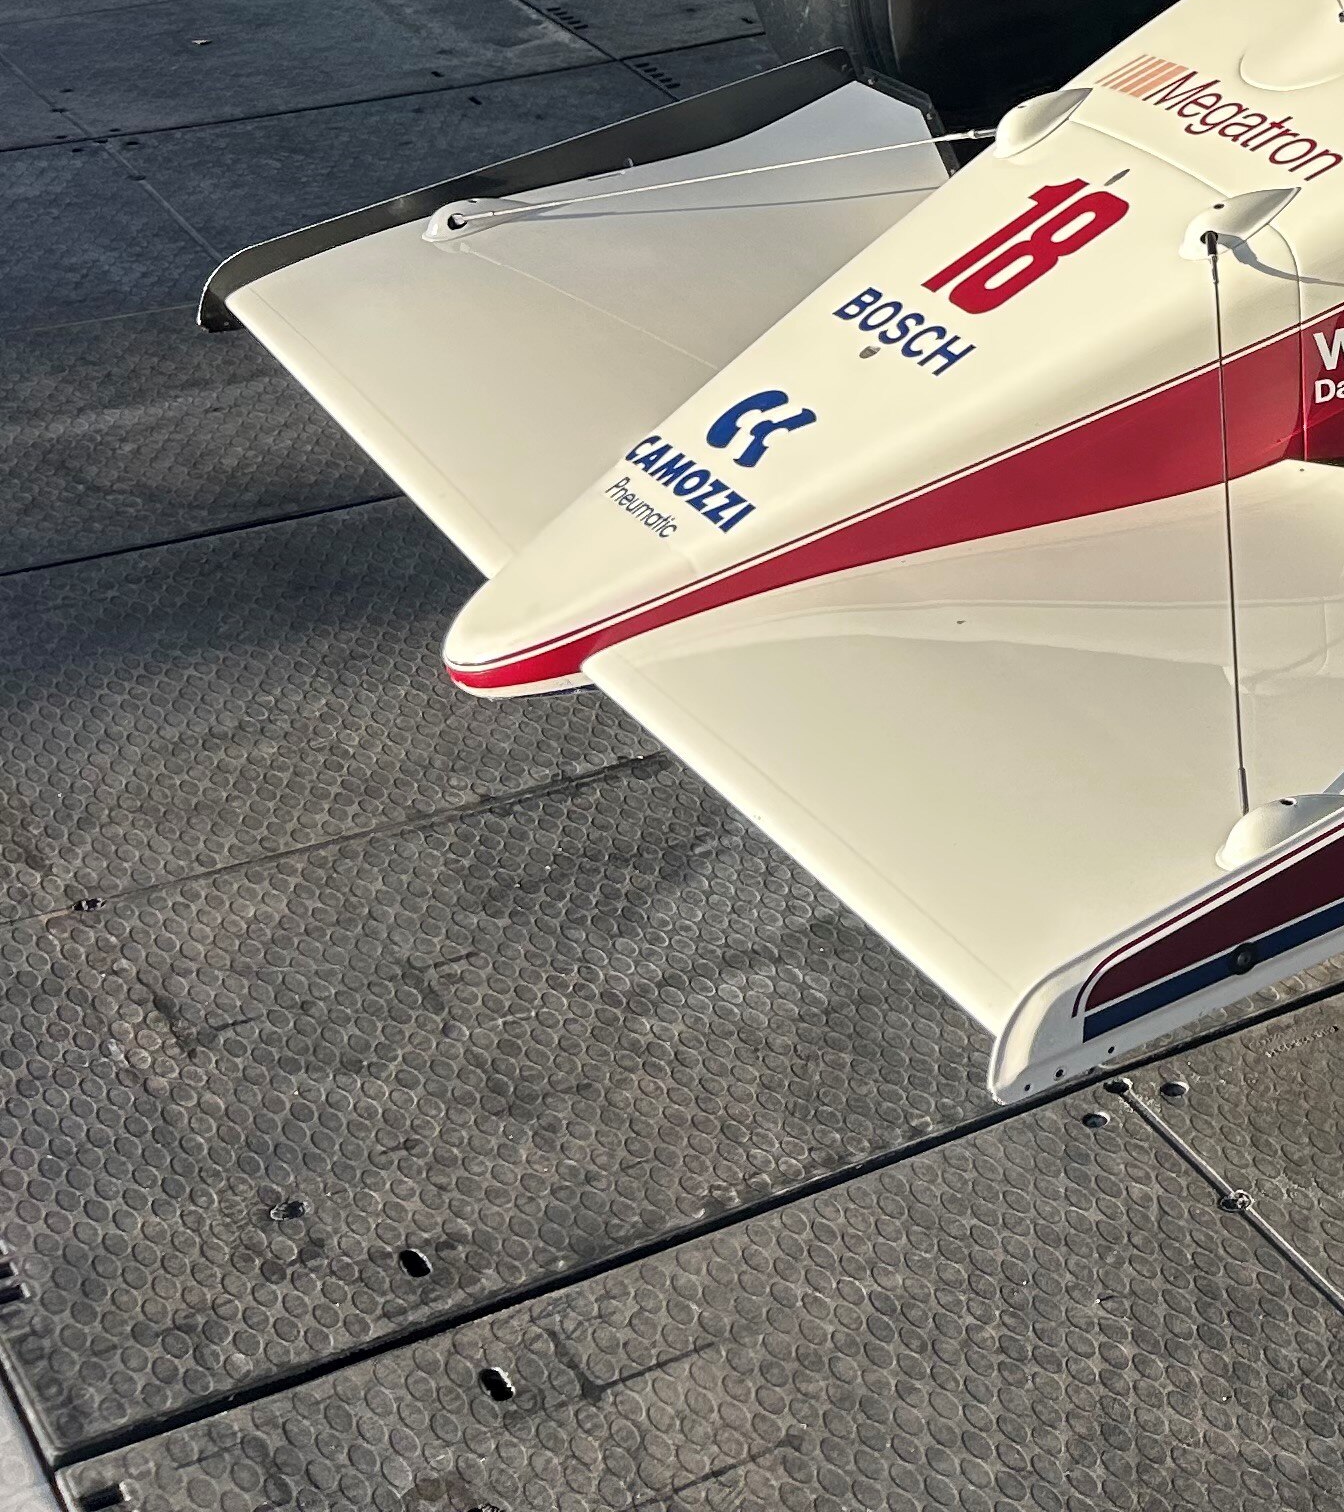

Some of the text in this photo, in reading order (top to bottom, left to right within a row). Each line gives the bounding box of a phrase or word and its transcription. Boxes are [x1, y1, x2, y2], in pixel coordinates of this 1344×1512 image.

[1142, 70, 1344, 181] Megatron
[920, 178, 1130, 315] 18
[832, 287, 977, 377] BOSCH
[605, 476, 678, 538] Pneumatic
[625, 435, 757, 533] CAMOZZI
